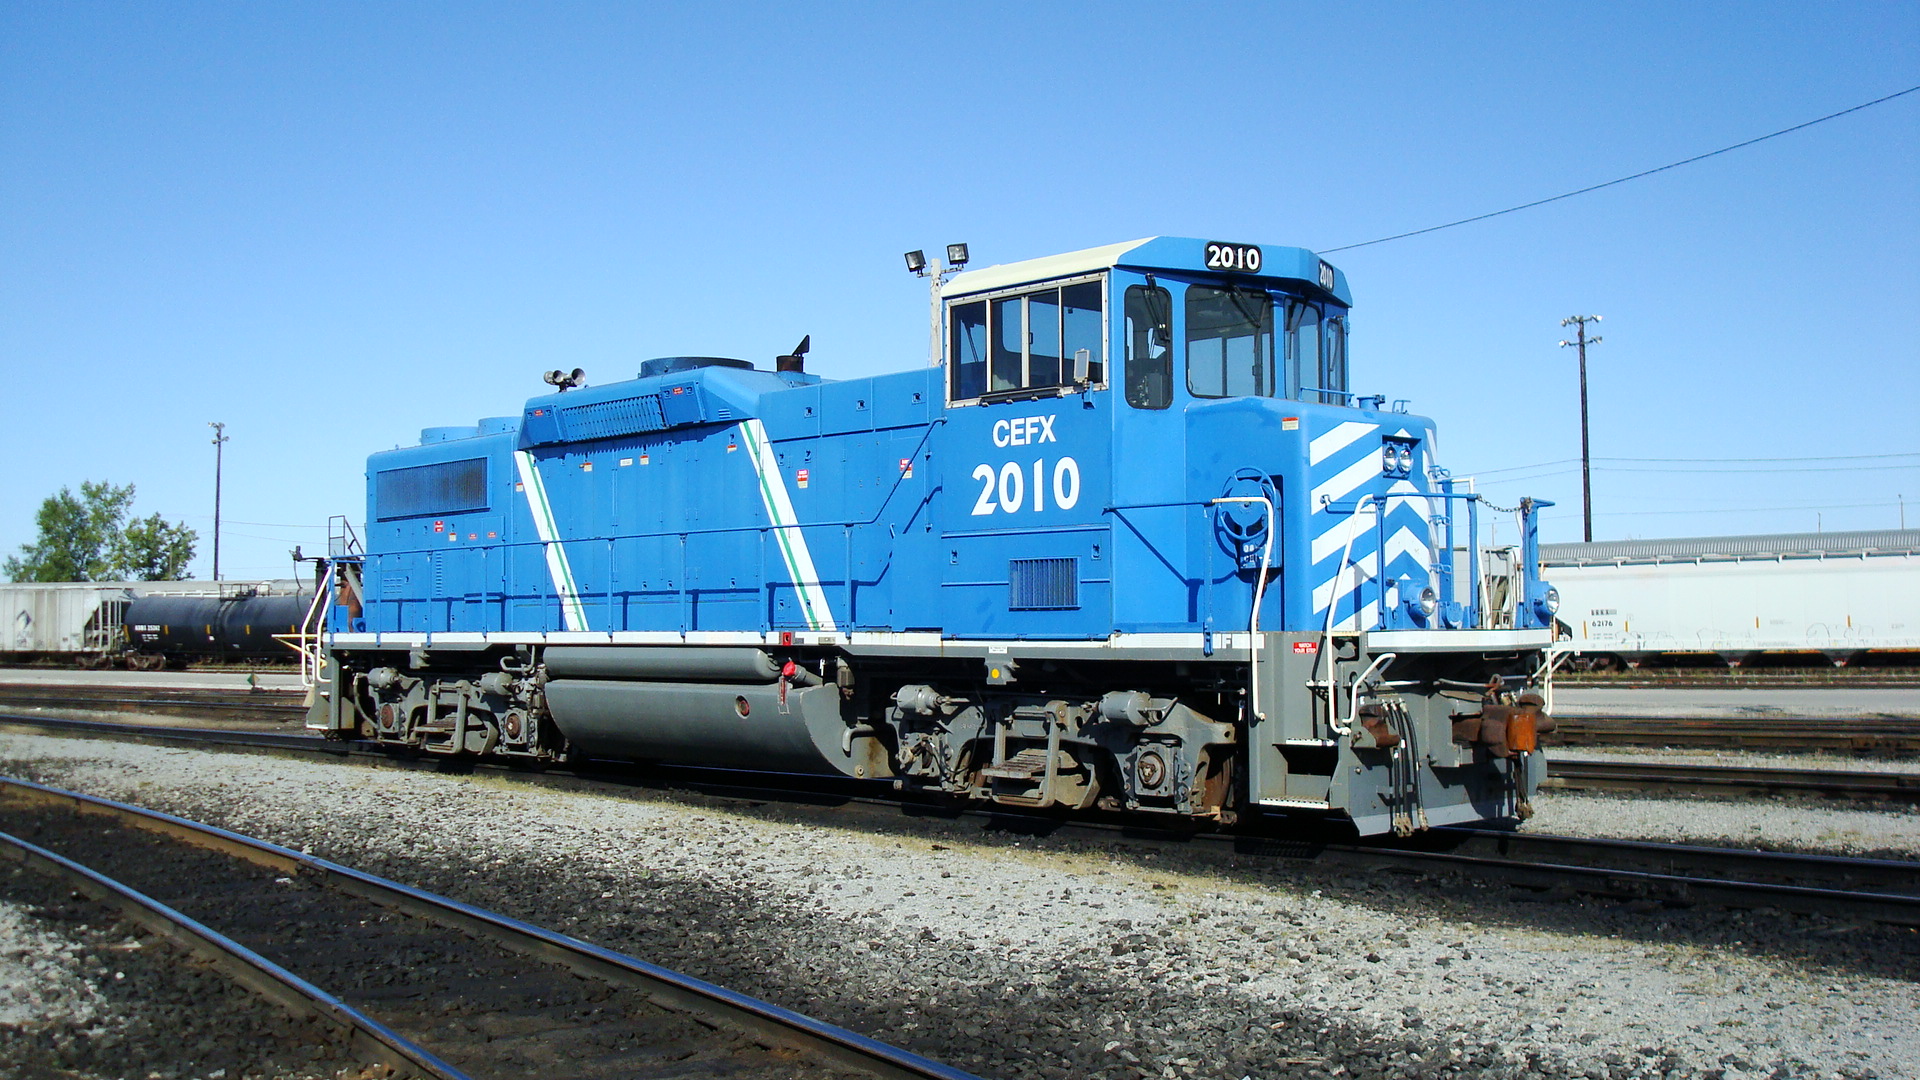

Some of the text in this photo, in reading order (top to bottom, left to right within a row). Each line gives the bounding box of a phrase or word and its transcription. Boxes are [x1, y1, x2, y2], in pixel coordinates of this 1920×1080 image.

[1207, 246, 1260, 270] 2010
[993, 414, 1057, 448] CEFX
[971, 456, 1080, 516] 2010
